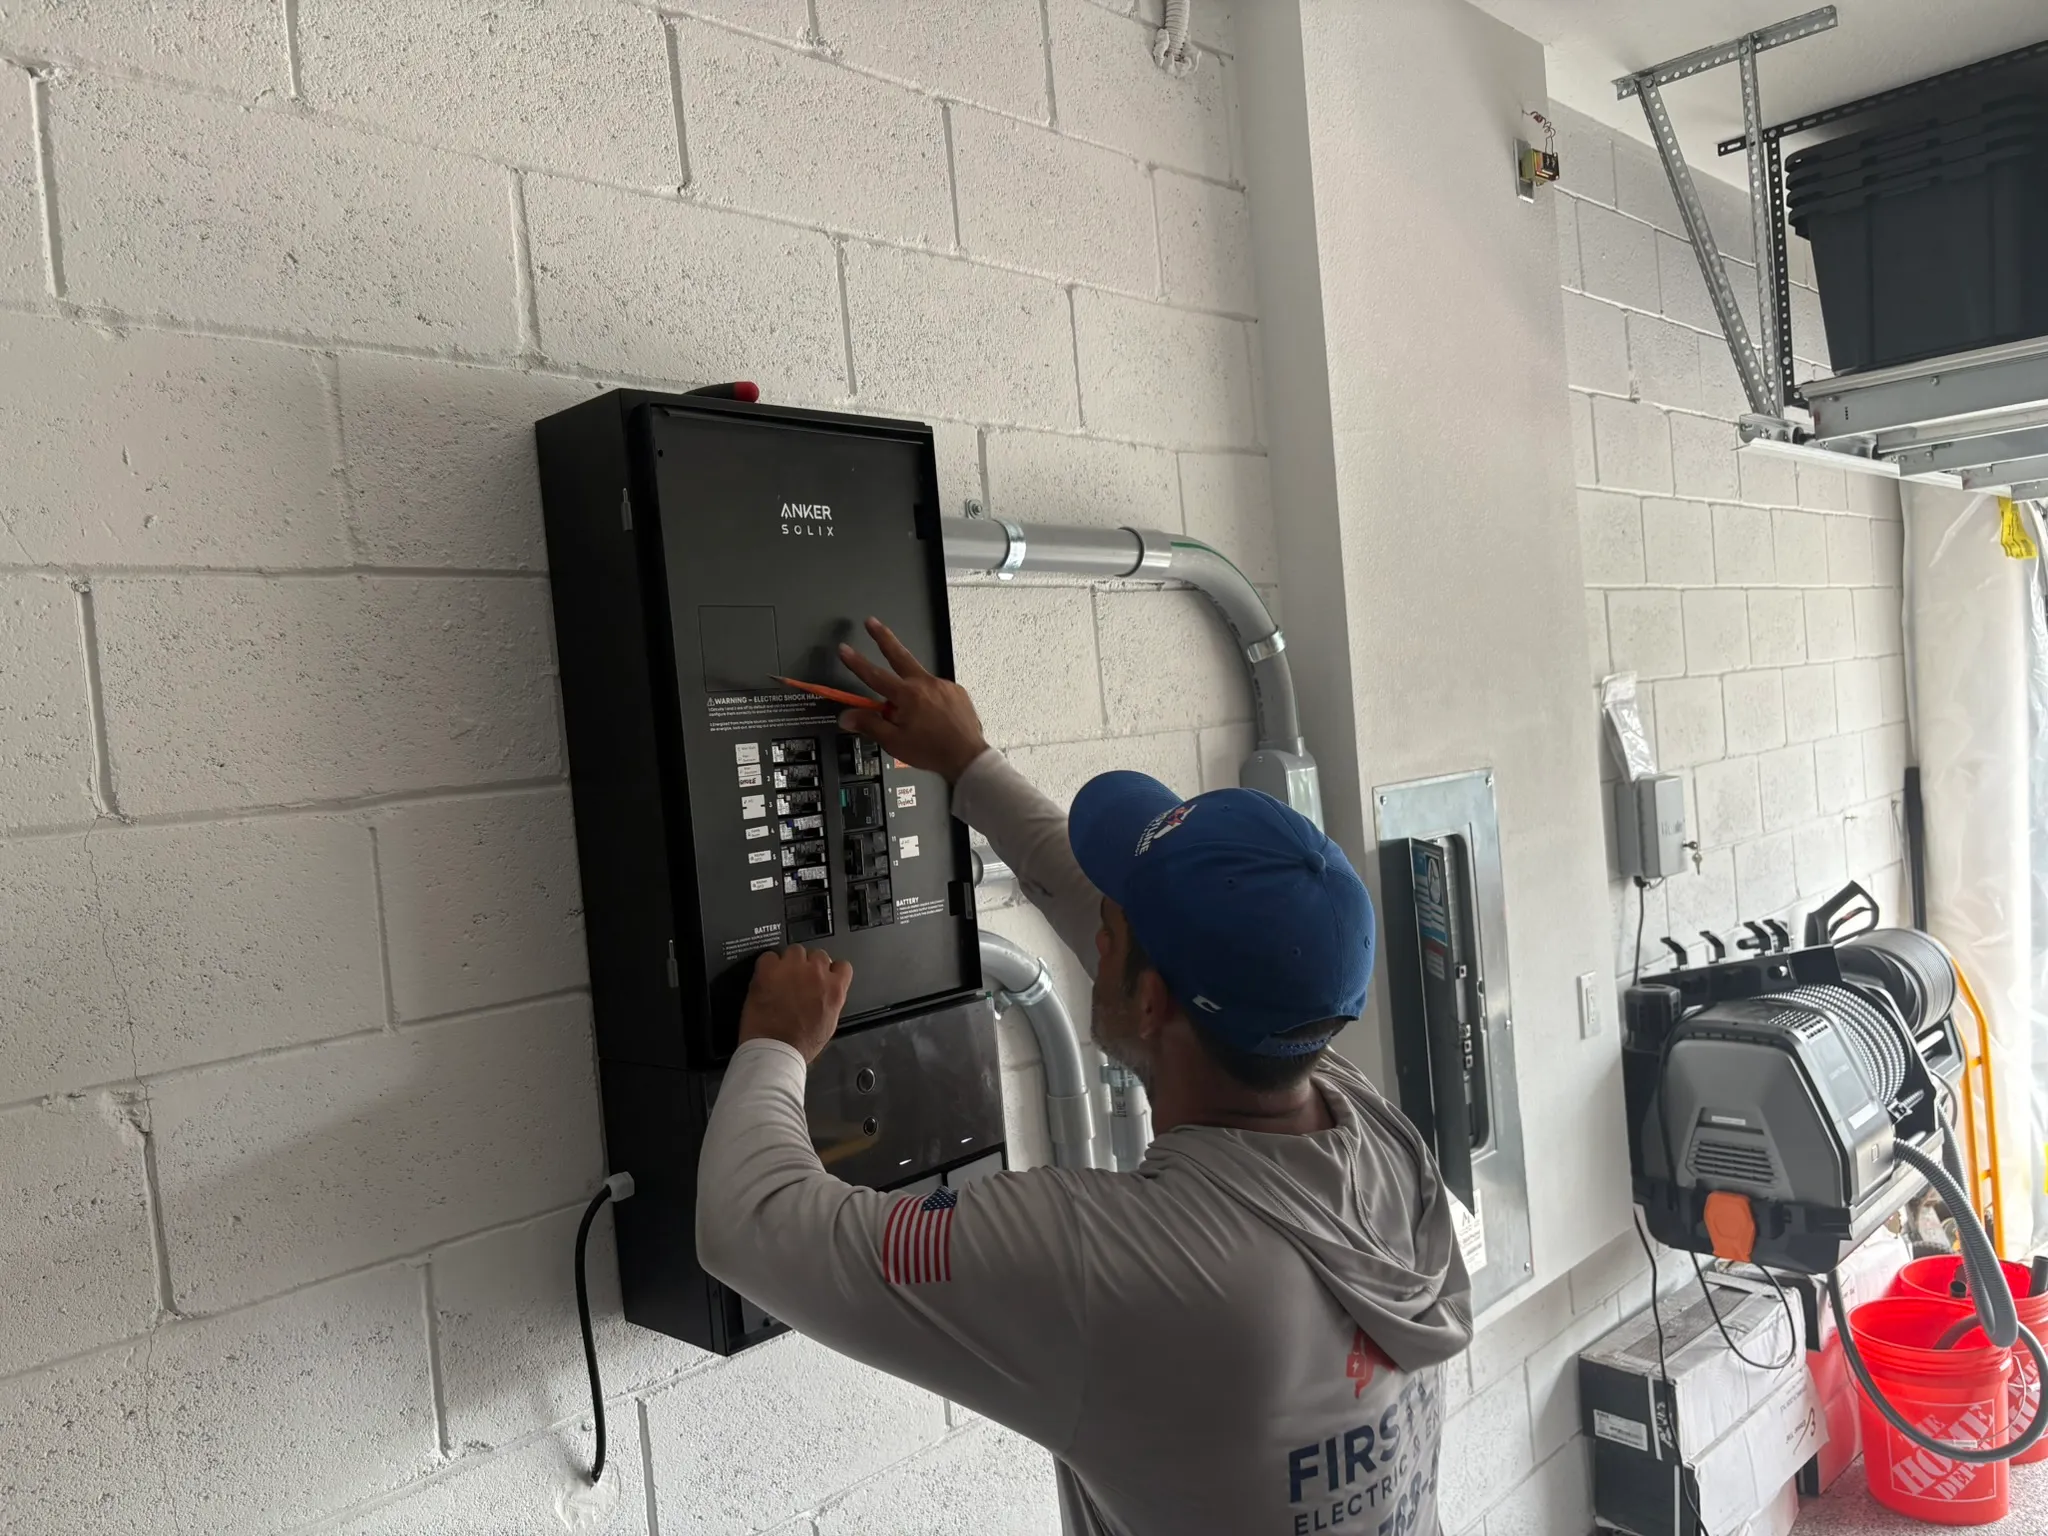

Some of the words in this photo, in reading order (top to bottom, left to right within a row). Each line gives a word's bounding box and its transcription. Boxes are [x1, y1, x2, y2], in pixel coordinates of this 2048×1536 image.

[781, 503, 833, 520] ANKER
[781, 524, 835, 537] SOLIX
[714, 696, 748, 705] WARNING
[753, 695, 783, 703] ELECTRIC
[896, 896, 919, 907] BATTERY
[754, 923, 781, 934] BATTERY
[1294, 1453, 1407, 1536] ELECTRIC
